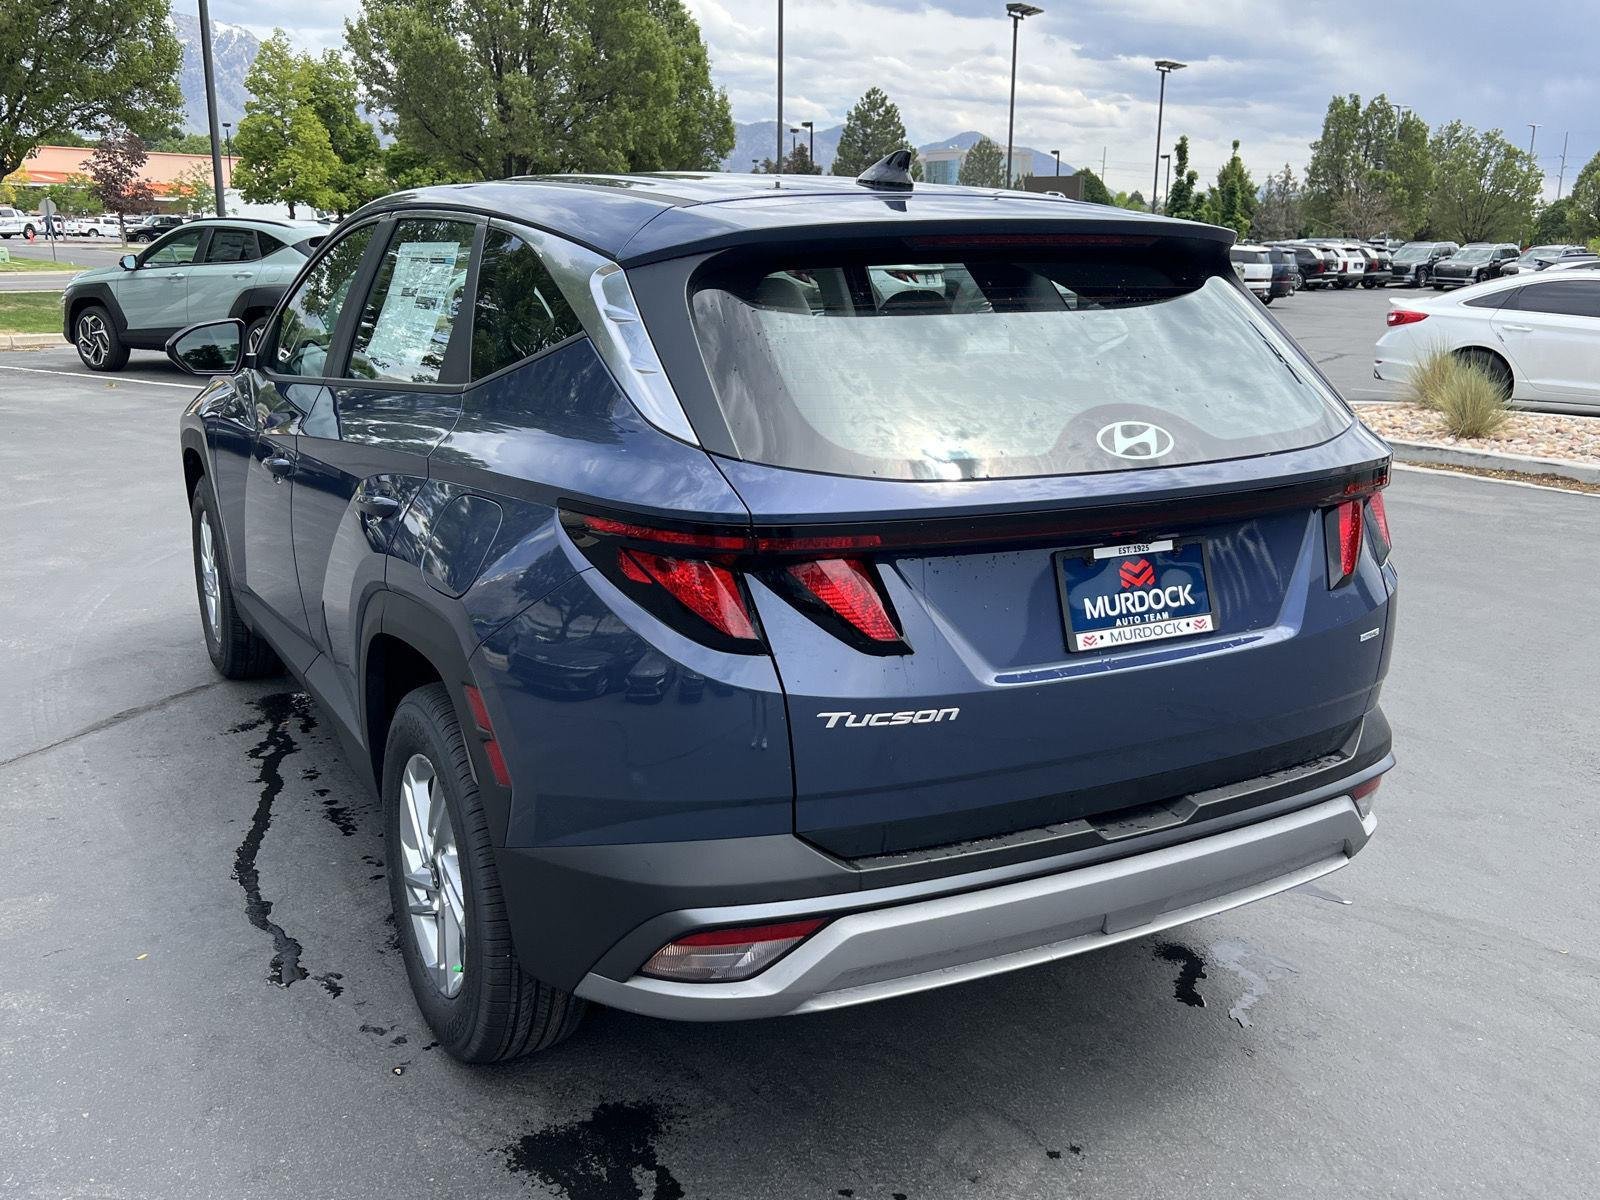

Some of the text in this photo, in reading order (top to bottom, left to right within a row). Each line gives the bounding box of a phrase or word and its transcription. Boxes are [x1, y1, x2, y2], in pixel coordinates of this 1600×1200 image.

[1118, 545, 1150, 555] EST. 1925
[1084, 584, 1194, 619] MURDOCK
[1116, 611, 1169, 626] AUTO TEAM
[1110, 622, 1183, 643] MURDOCK
